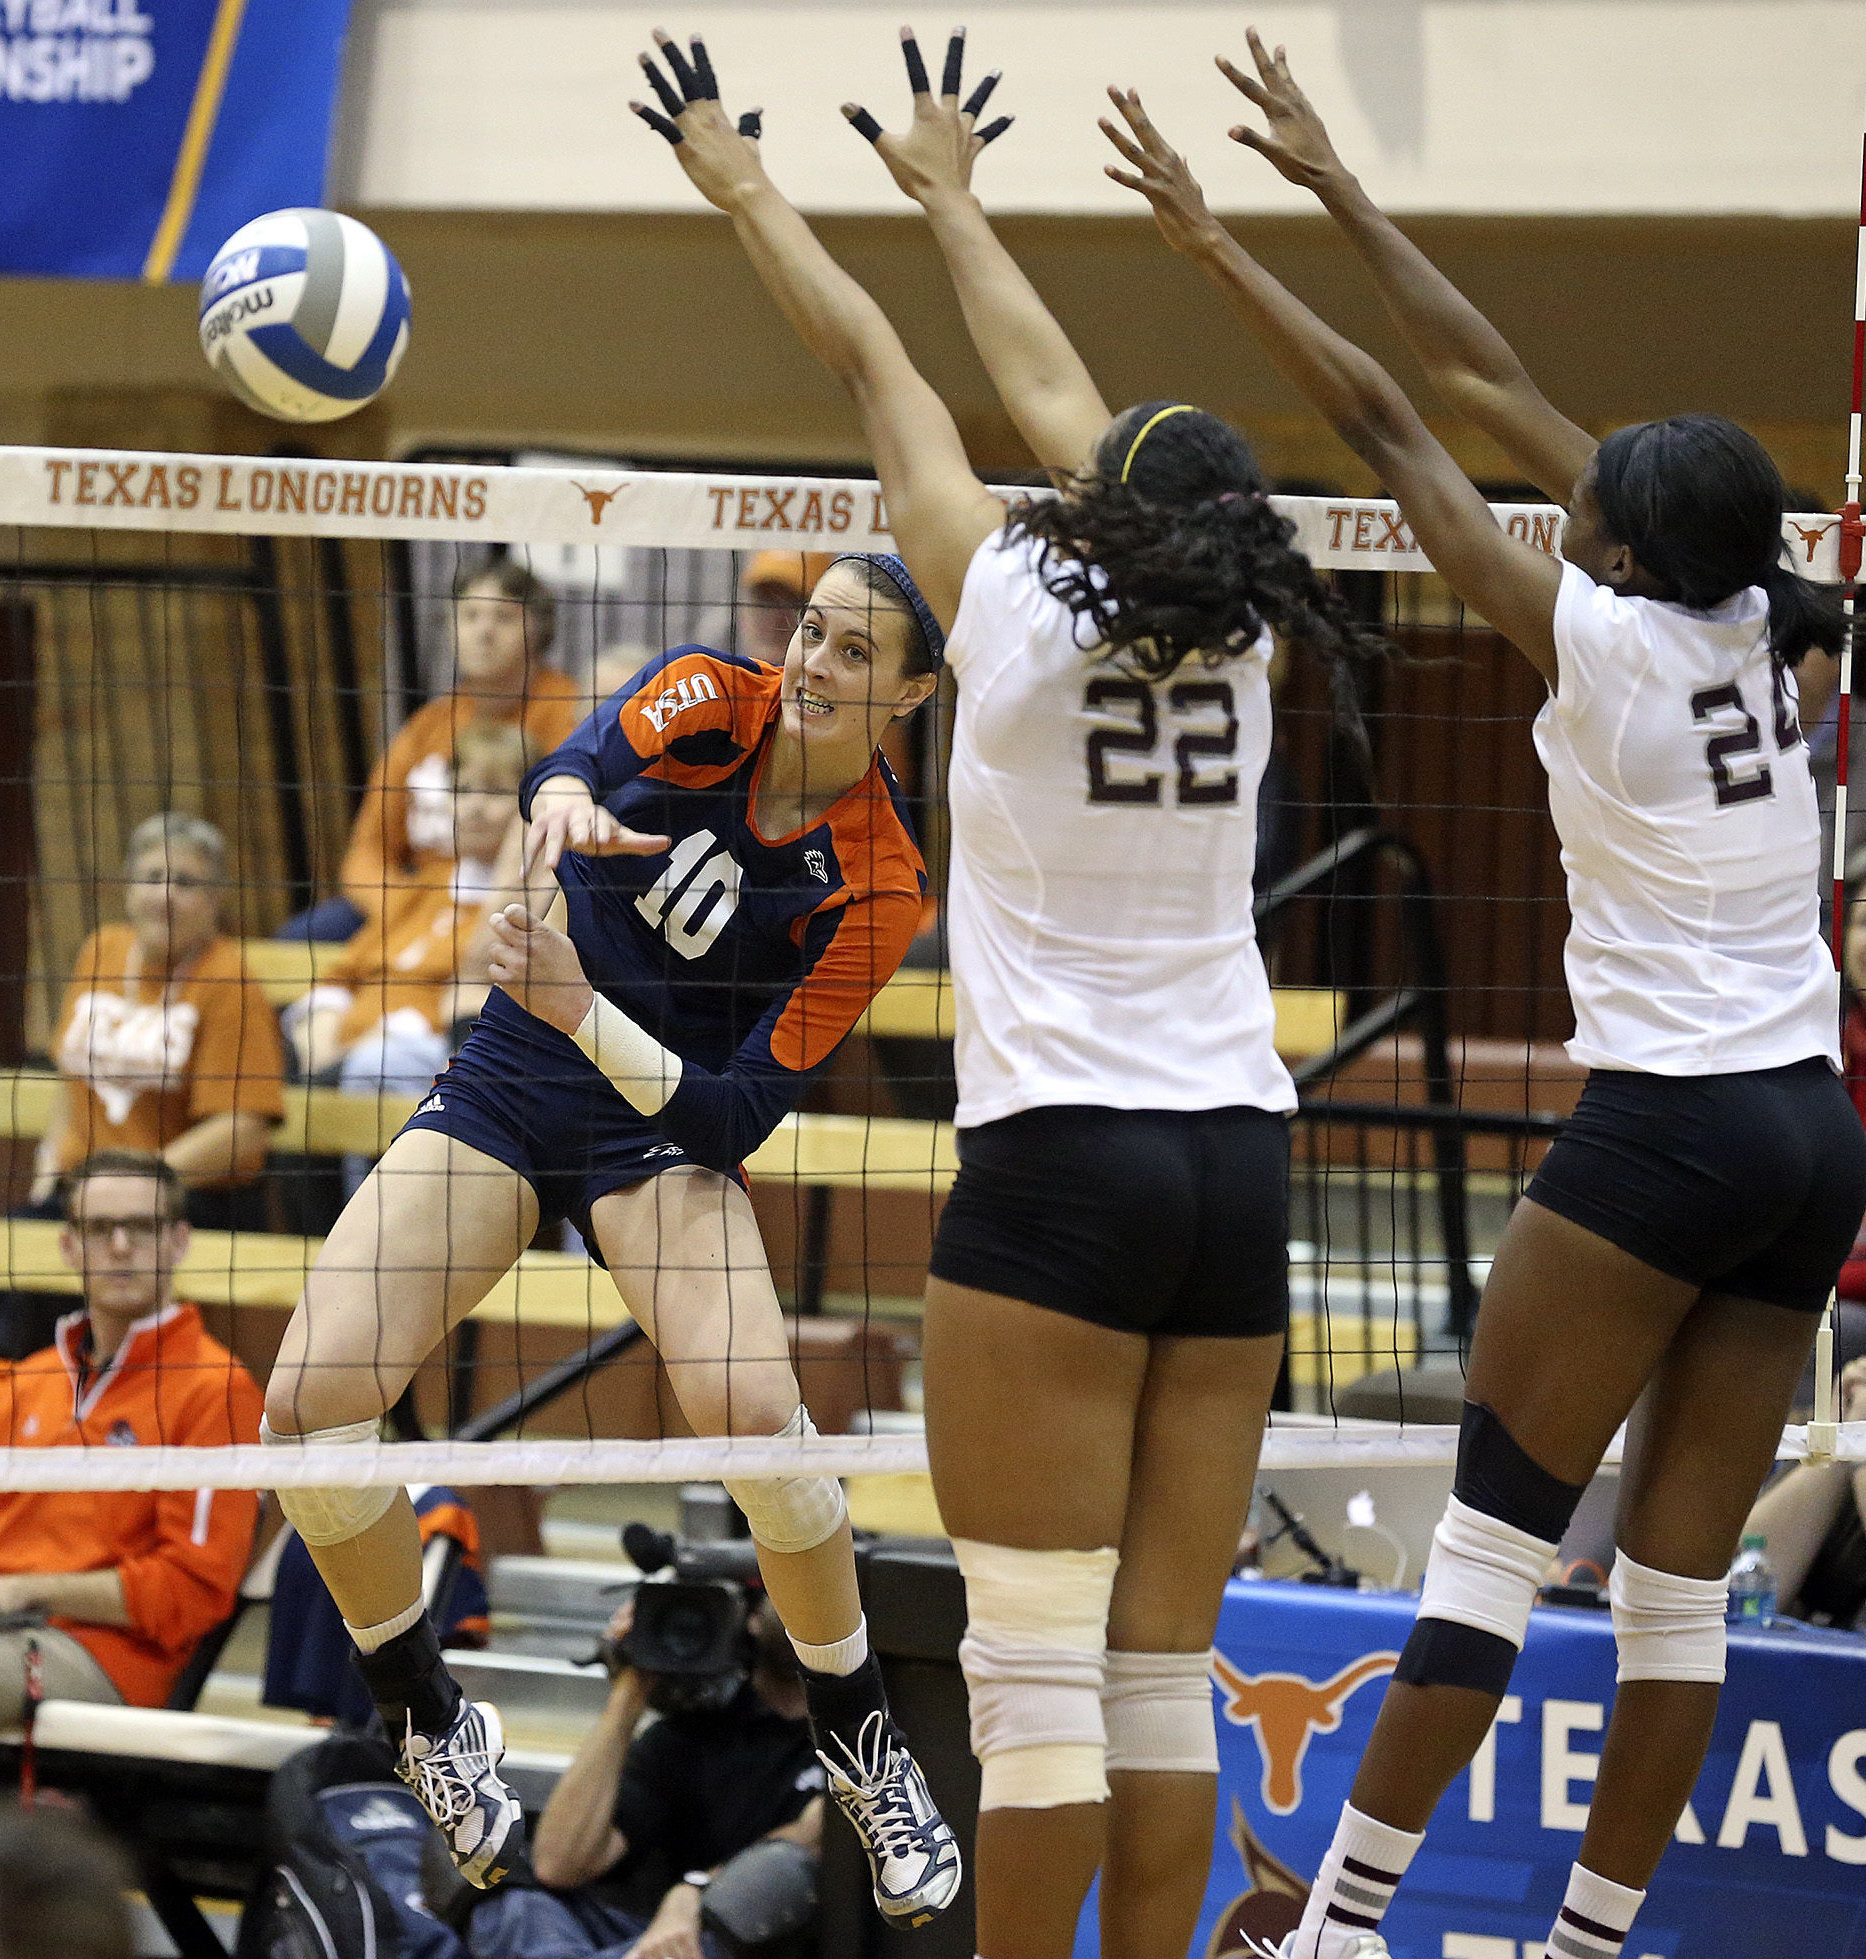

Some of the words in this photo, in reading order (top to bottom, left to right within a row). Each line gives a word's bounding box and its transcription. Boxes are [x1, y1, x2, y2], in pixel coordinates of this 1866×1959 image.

[45, 460, 201, 509] TEXAS
[215, 466, 488, 520] LONGHORNS
[708, 487, 854, 534] TEXAS
[1327, 507, 1419, 552] TEX
[640, 673, 718, 733] UTSA
[1083, 678, 1239, 806] 22
[634, 829, 743, 960] 10
[1468, 1695, 1866, 1865] TEAS
